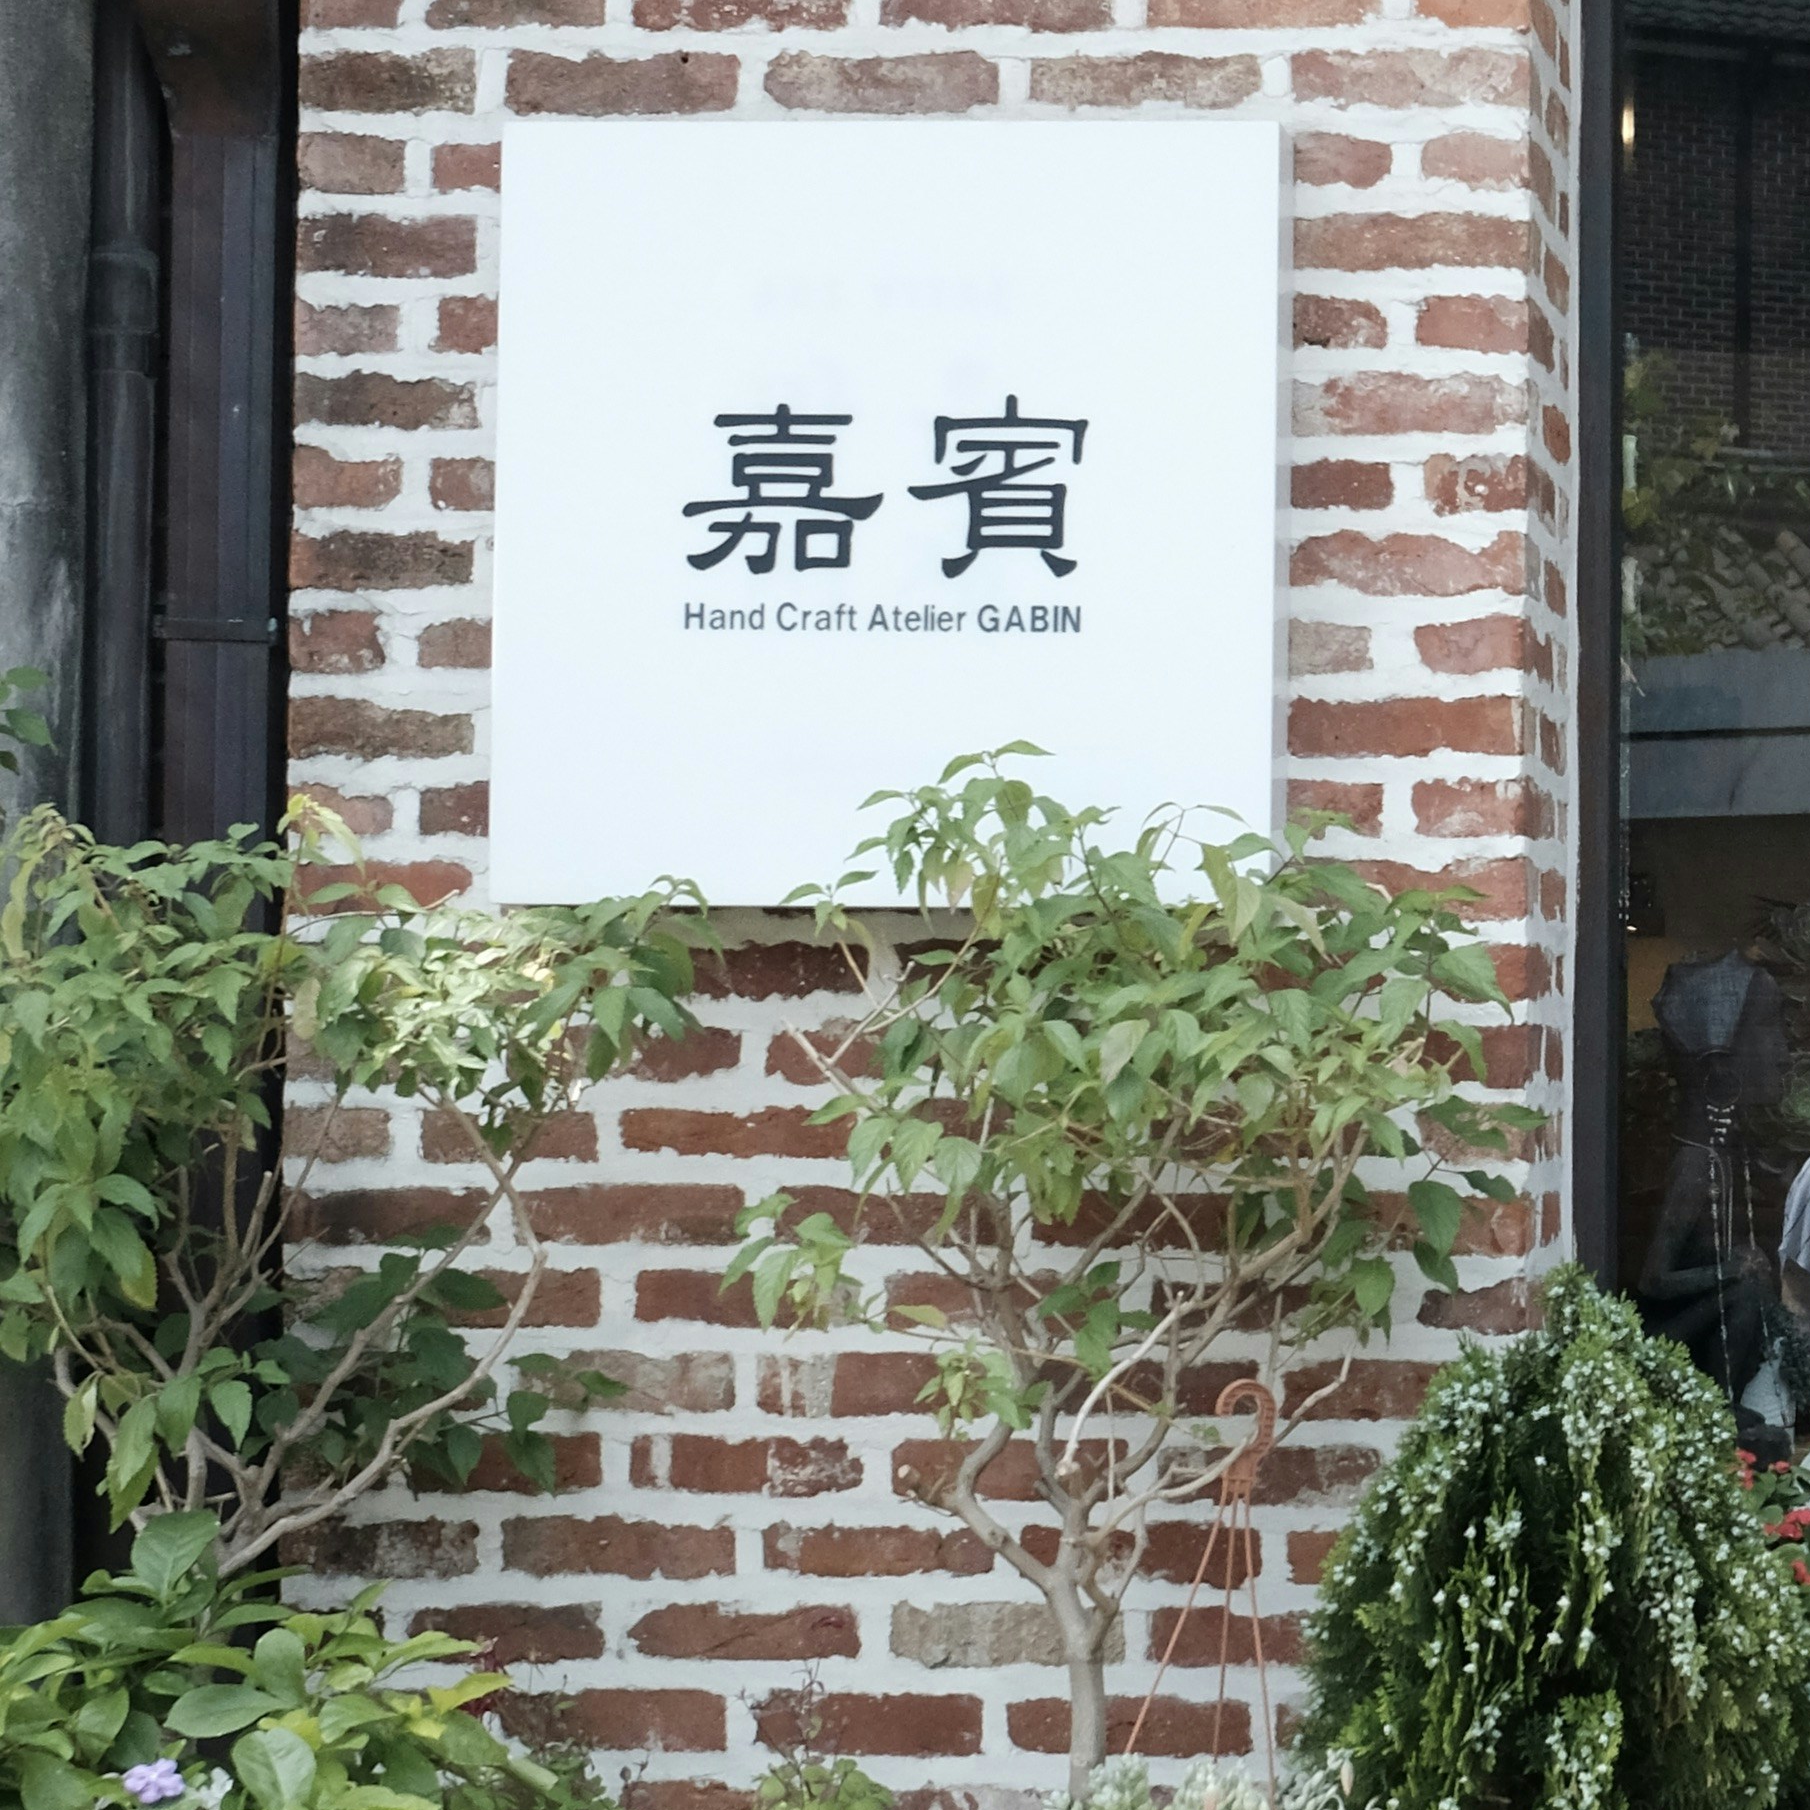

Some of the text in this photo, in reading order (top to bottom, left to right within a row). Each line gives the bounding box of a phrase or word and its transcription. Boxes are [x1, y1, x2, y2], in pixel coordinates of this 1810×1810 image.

[681, 393, 1089, 579] 嘉賓
[684, 601, 1082, 634] Hand Craft Atelier GABIN
